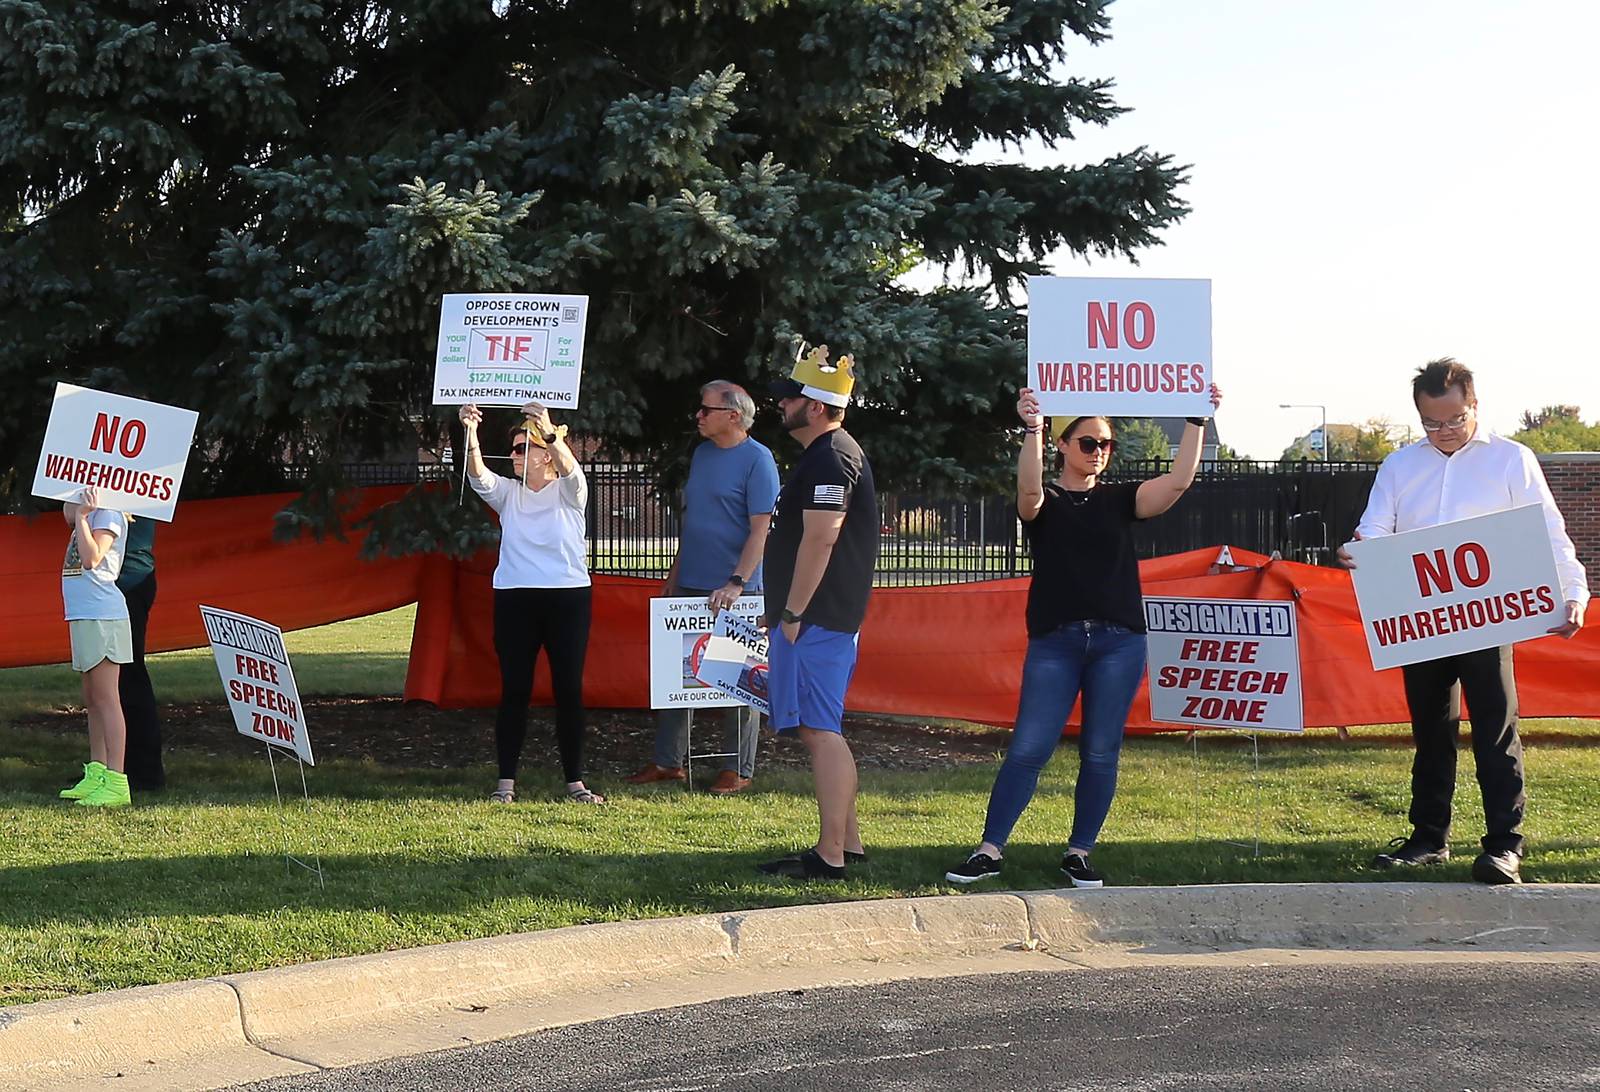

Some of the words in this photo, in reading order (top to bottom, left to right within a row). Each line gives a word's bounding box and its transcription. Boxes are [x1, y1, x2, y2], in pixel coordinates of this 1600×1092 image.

[466, 301, 511, 311] OPPOSE
[514, 301, 560, 312] CROWN
[464, 316, 559, 327] DEVELOPMENT'S
[1087, 301, 1156, 350] NO
[446, 335, 467, 343] YOUR
[485, 336, 532, 361] TIF
[558, 337, 572, 345] For
[442, 355, 466, 363] dollars
[468, 373, 492, 384] $127
[494, 373, 542, 385] MILLION
[1037, 363, 1205, 393] WAREHOUSES
[439, 388, 457, 397] TAX
[458, 388, 513, 398] INCREMENT
[515, 389, 572, 401] FINANCING
[89, 412, 147, 459] NO
[45, 453, 174, 501] WAREHOUSES
[1411, 541, 1491, 598] NO
[669, 603, 683, 611] SAY
[684, 603, 702, 611] "NO"
[1147, 602, 1289, 636] DESIGNATED
[1372, 585, 1555, 647] WAREHOUSES
[724, 615, 741, 628] SAY
[205, 613, 285, 664] DESIGNATED
[726, 627, 769, 658] WARE
[1179, 638, 1259, 664] FREE
[235, 653, 280, 686] FREE
[1157, 666, 1289, 695] SPEECH
[229, 679, 298, 722] SPEECH
[668, 693, 689, 702] SAVE
[690, 692, 707, 701] OUR
[717, 679, 735, 693] SAVE
[735, 688, 752, 702] OUR
[1180, 696, 1268, 723] ZONE
[251, 712, 297, 746] ZONE
